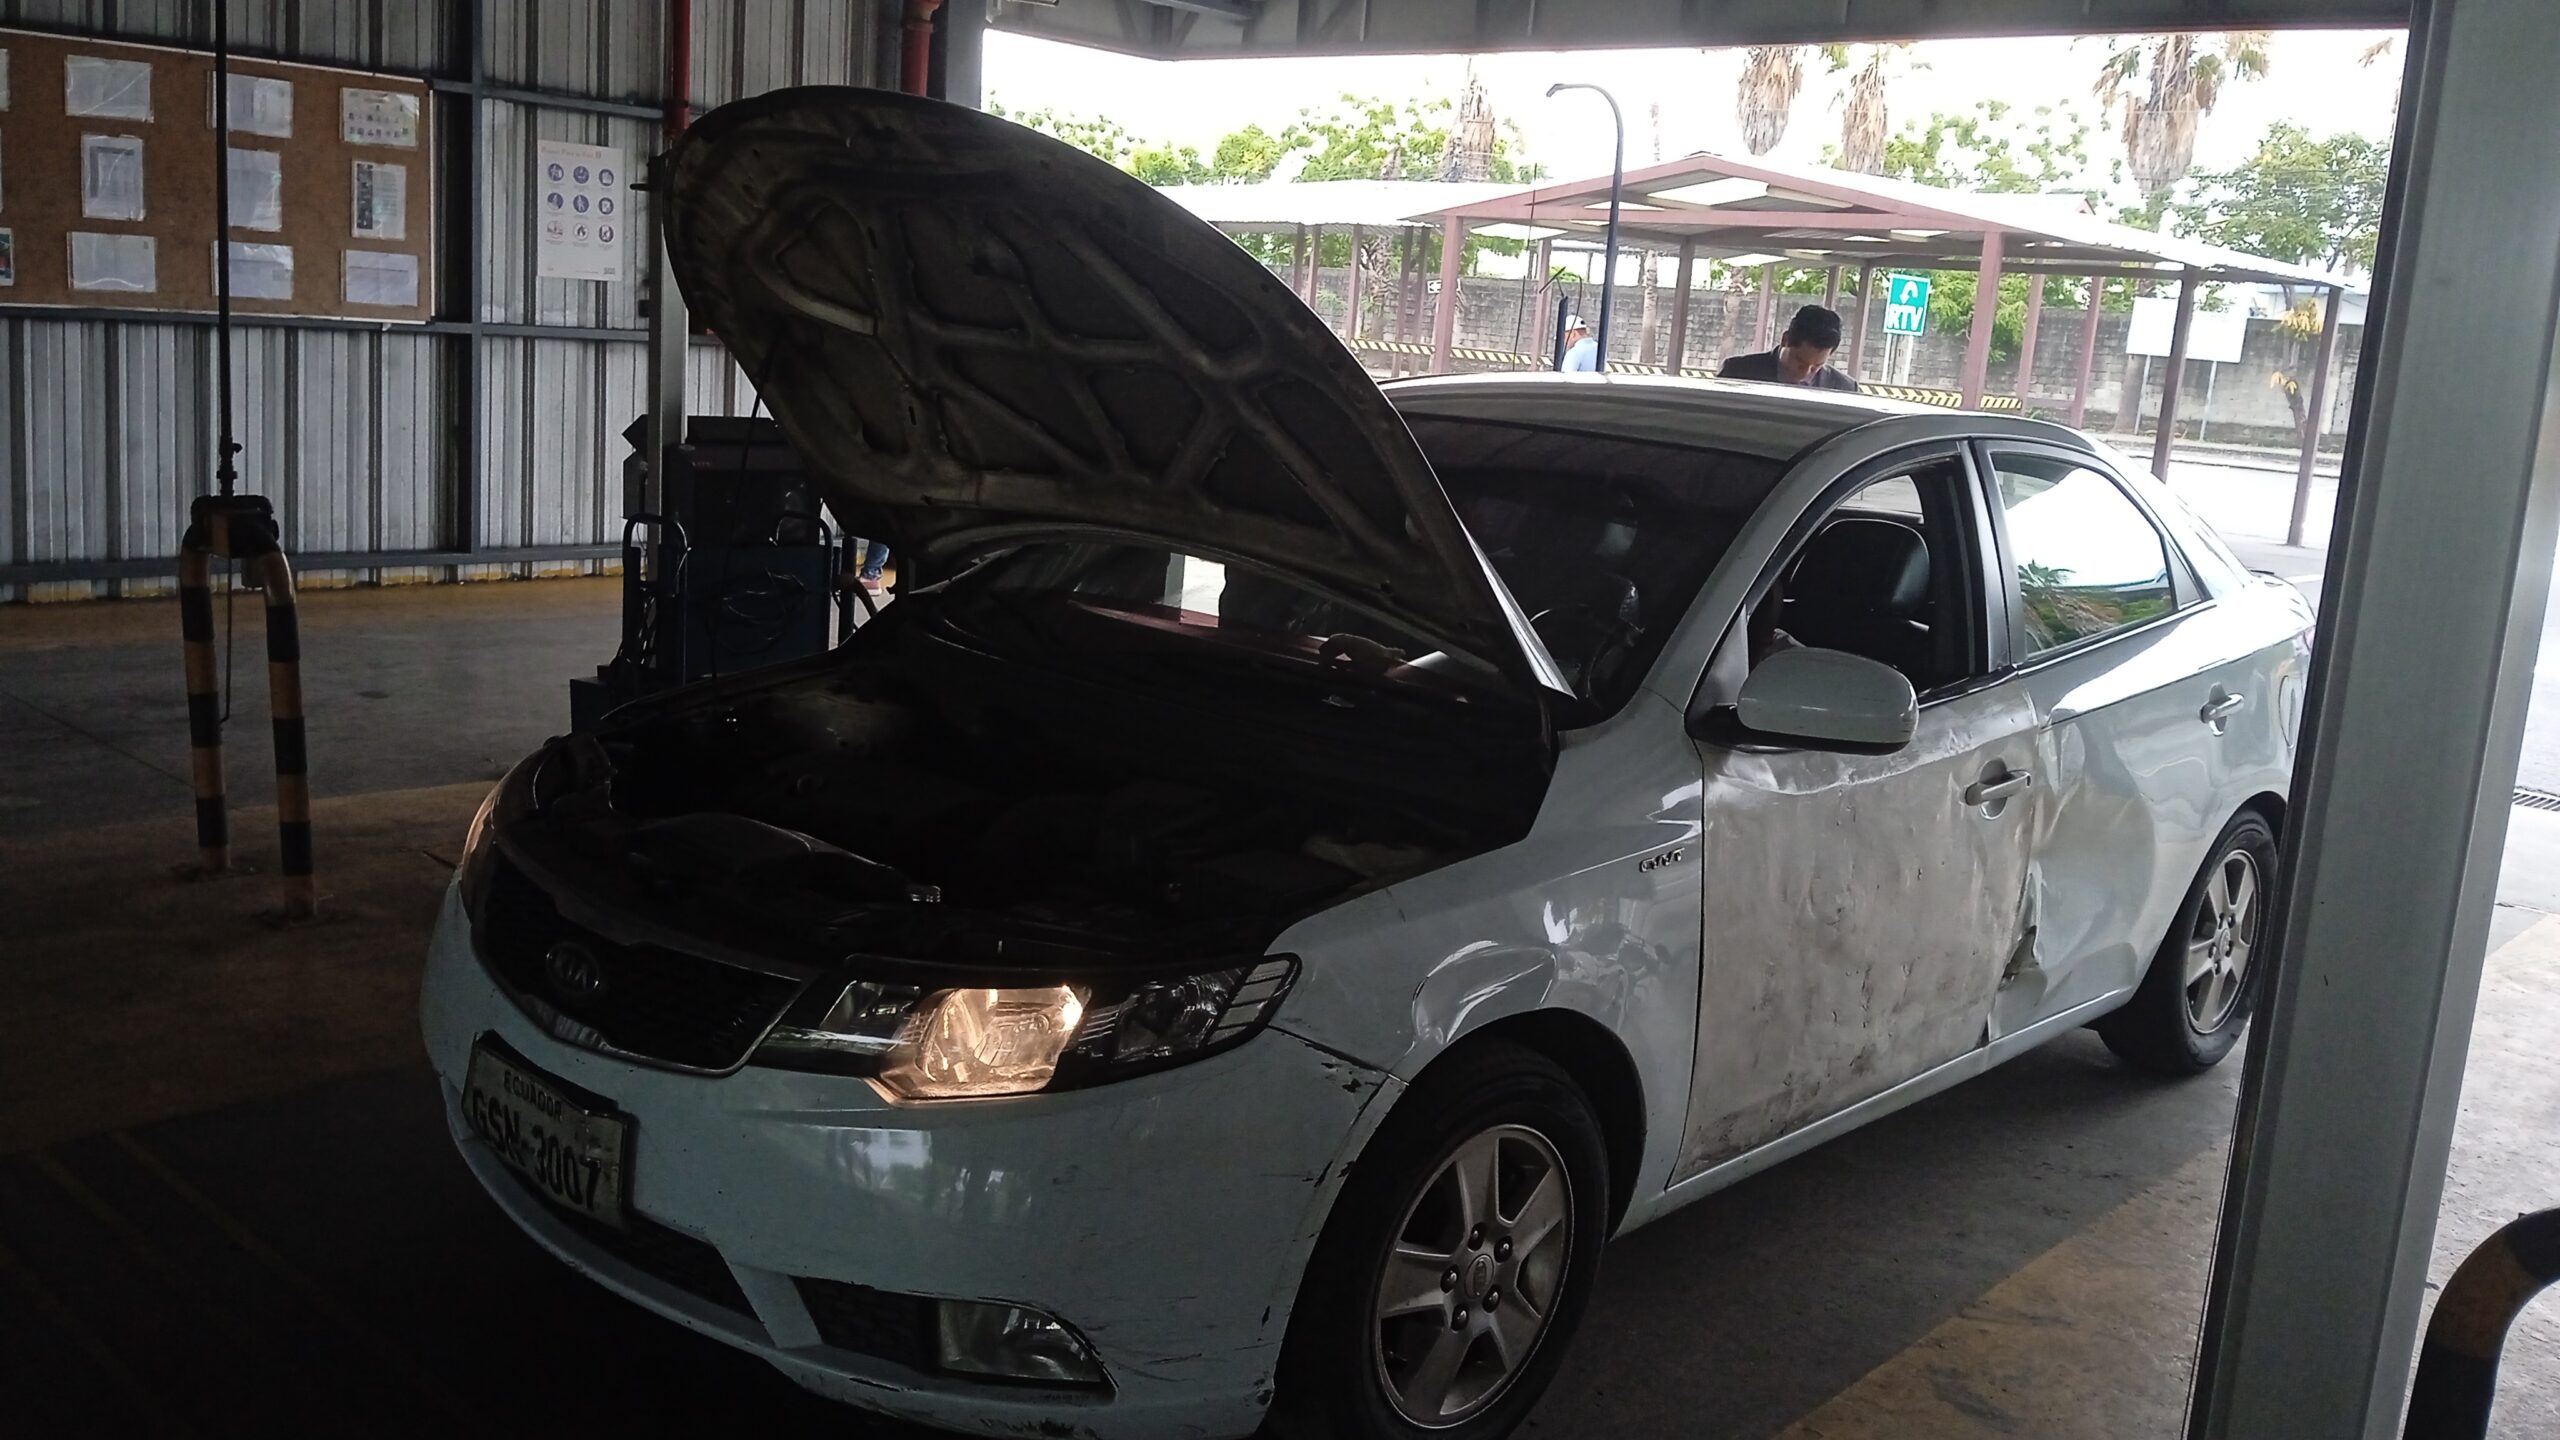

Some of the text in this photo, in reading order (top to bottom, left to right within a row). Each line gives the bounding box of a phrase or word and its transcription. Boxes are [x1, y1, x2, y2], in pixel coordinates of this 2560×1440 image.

[1888, 304, 1924, 331] RTV
[504, 1070, 562, 1122] ECUADOR
[472, 1088, 601, 1212] GSN-3007
